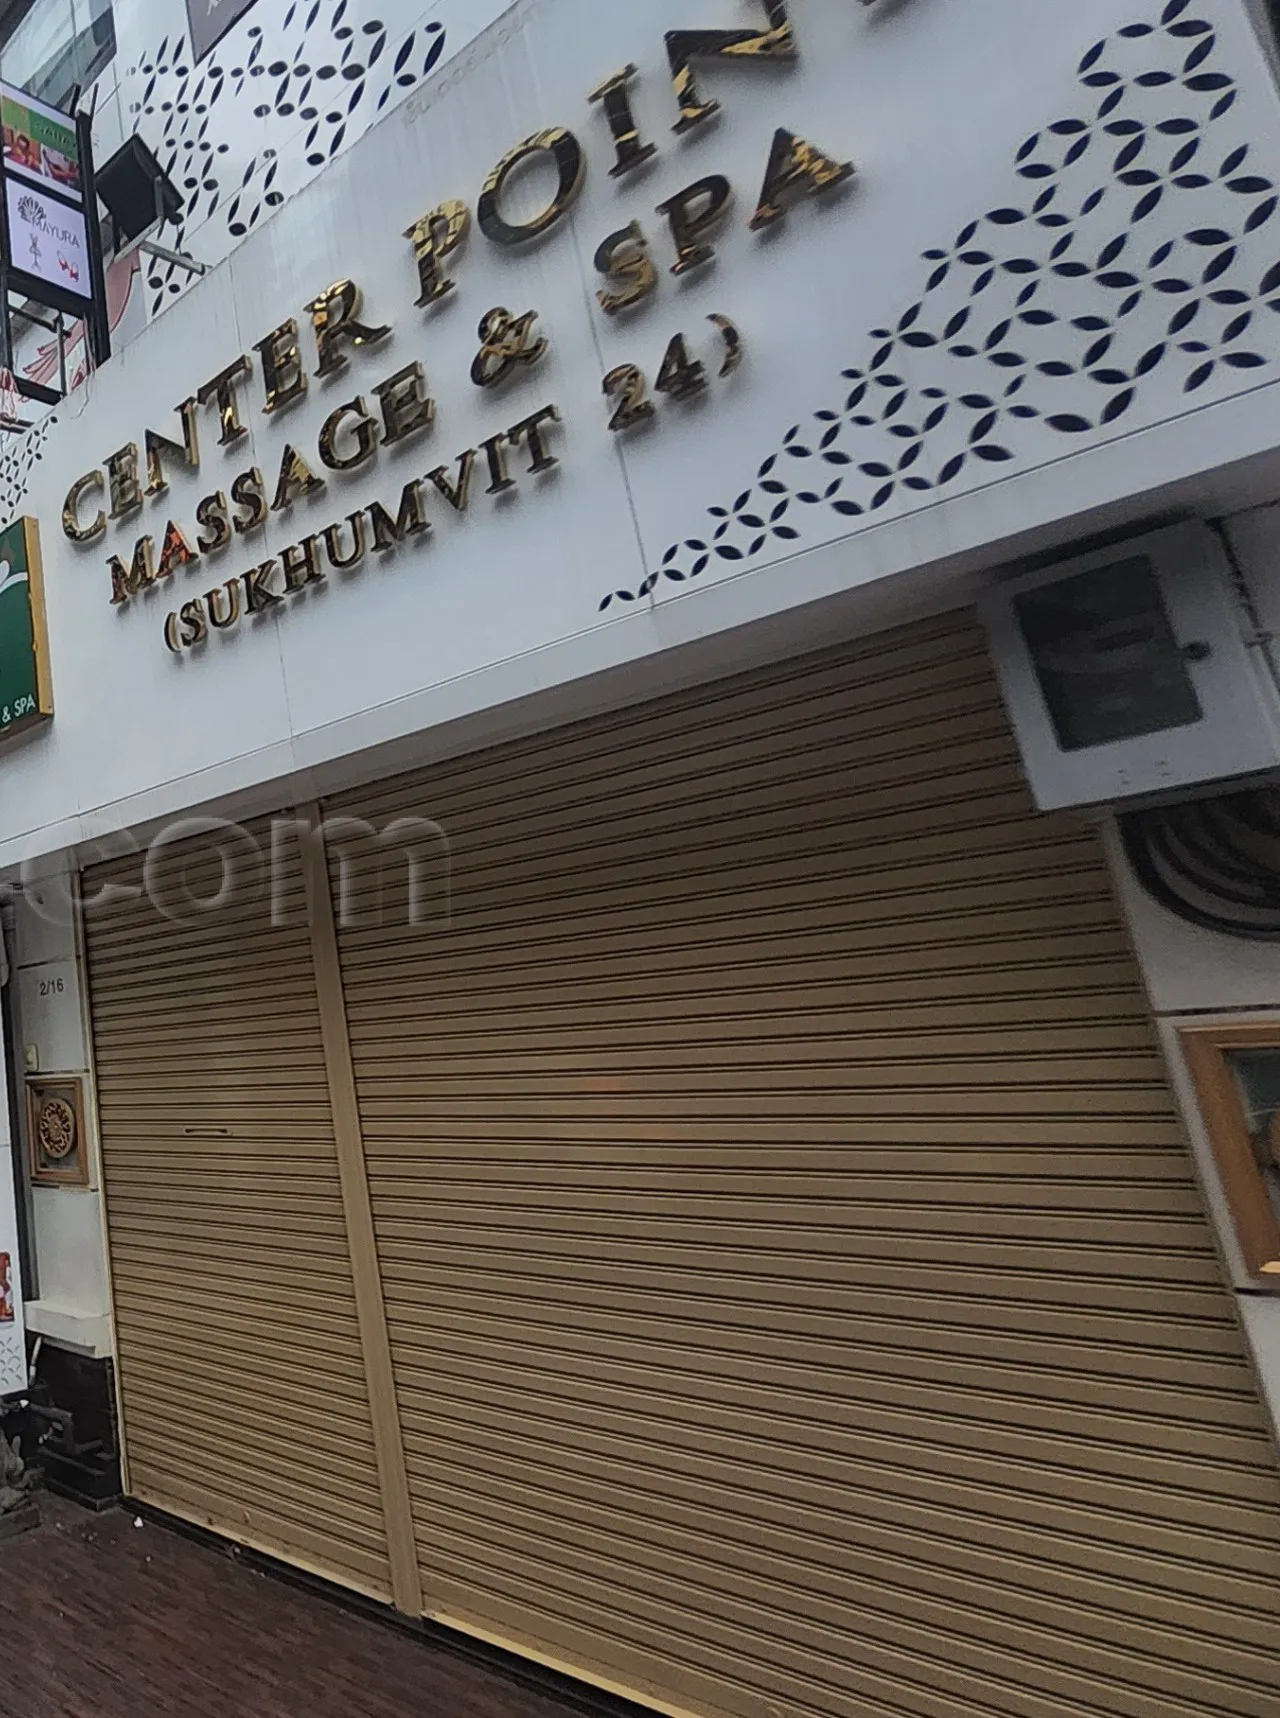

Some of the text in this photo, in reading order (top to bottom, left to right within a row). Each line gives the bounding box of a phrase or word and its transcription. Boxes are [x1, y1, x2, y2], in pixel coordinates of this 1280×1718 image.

[31, 215, 80, 248] MAYURA
[61, 0, 885, 543] CENTER POIN
[106, 127, 856, 604] MASSAGE & SPA
[164, 313, 744, 652] (SUKHUMVIT 24)
[2, 705, 11, 723] &
[14, 693, 36, 717] SPA
[40, 977, 64, 996] 2/16
